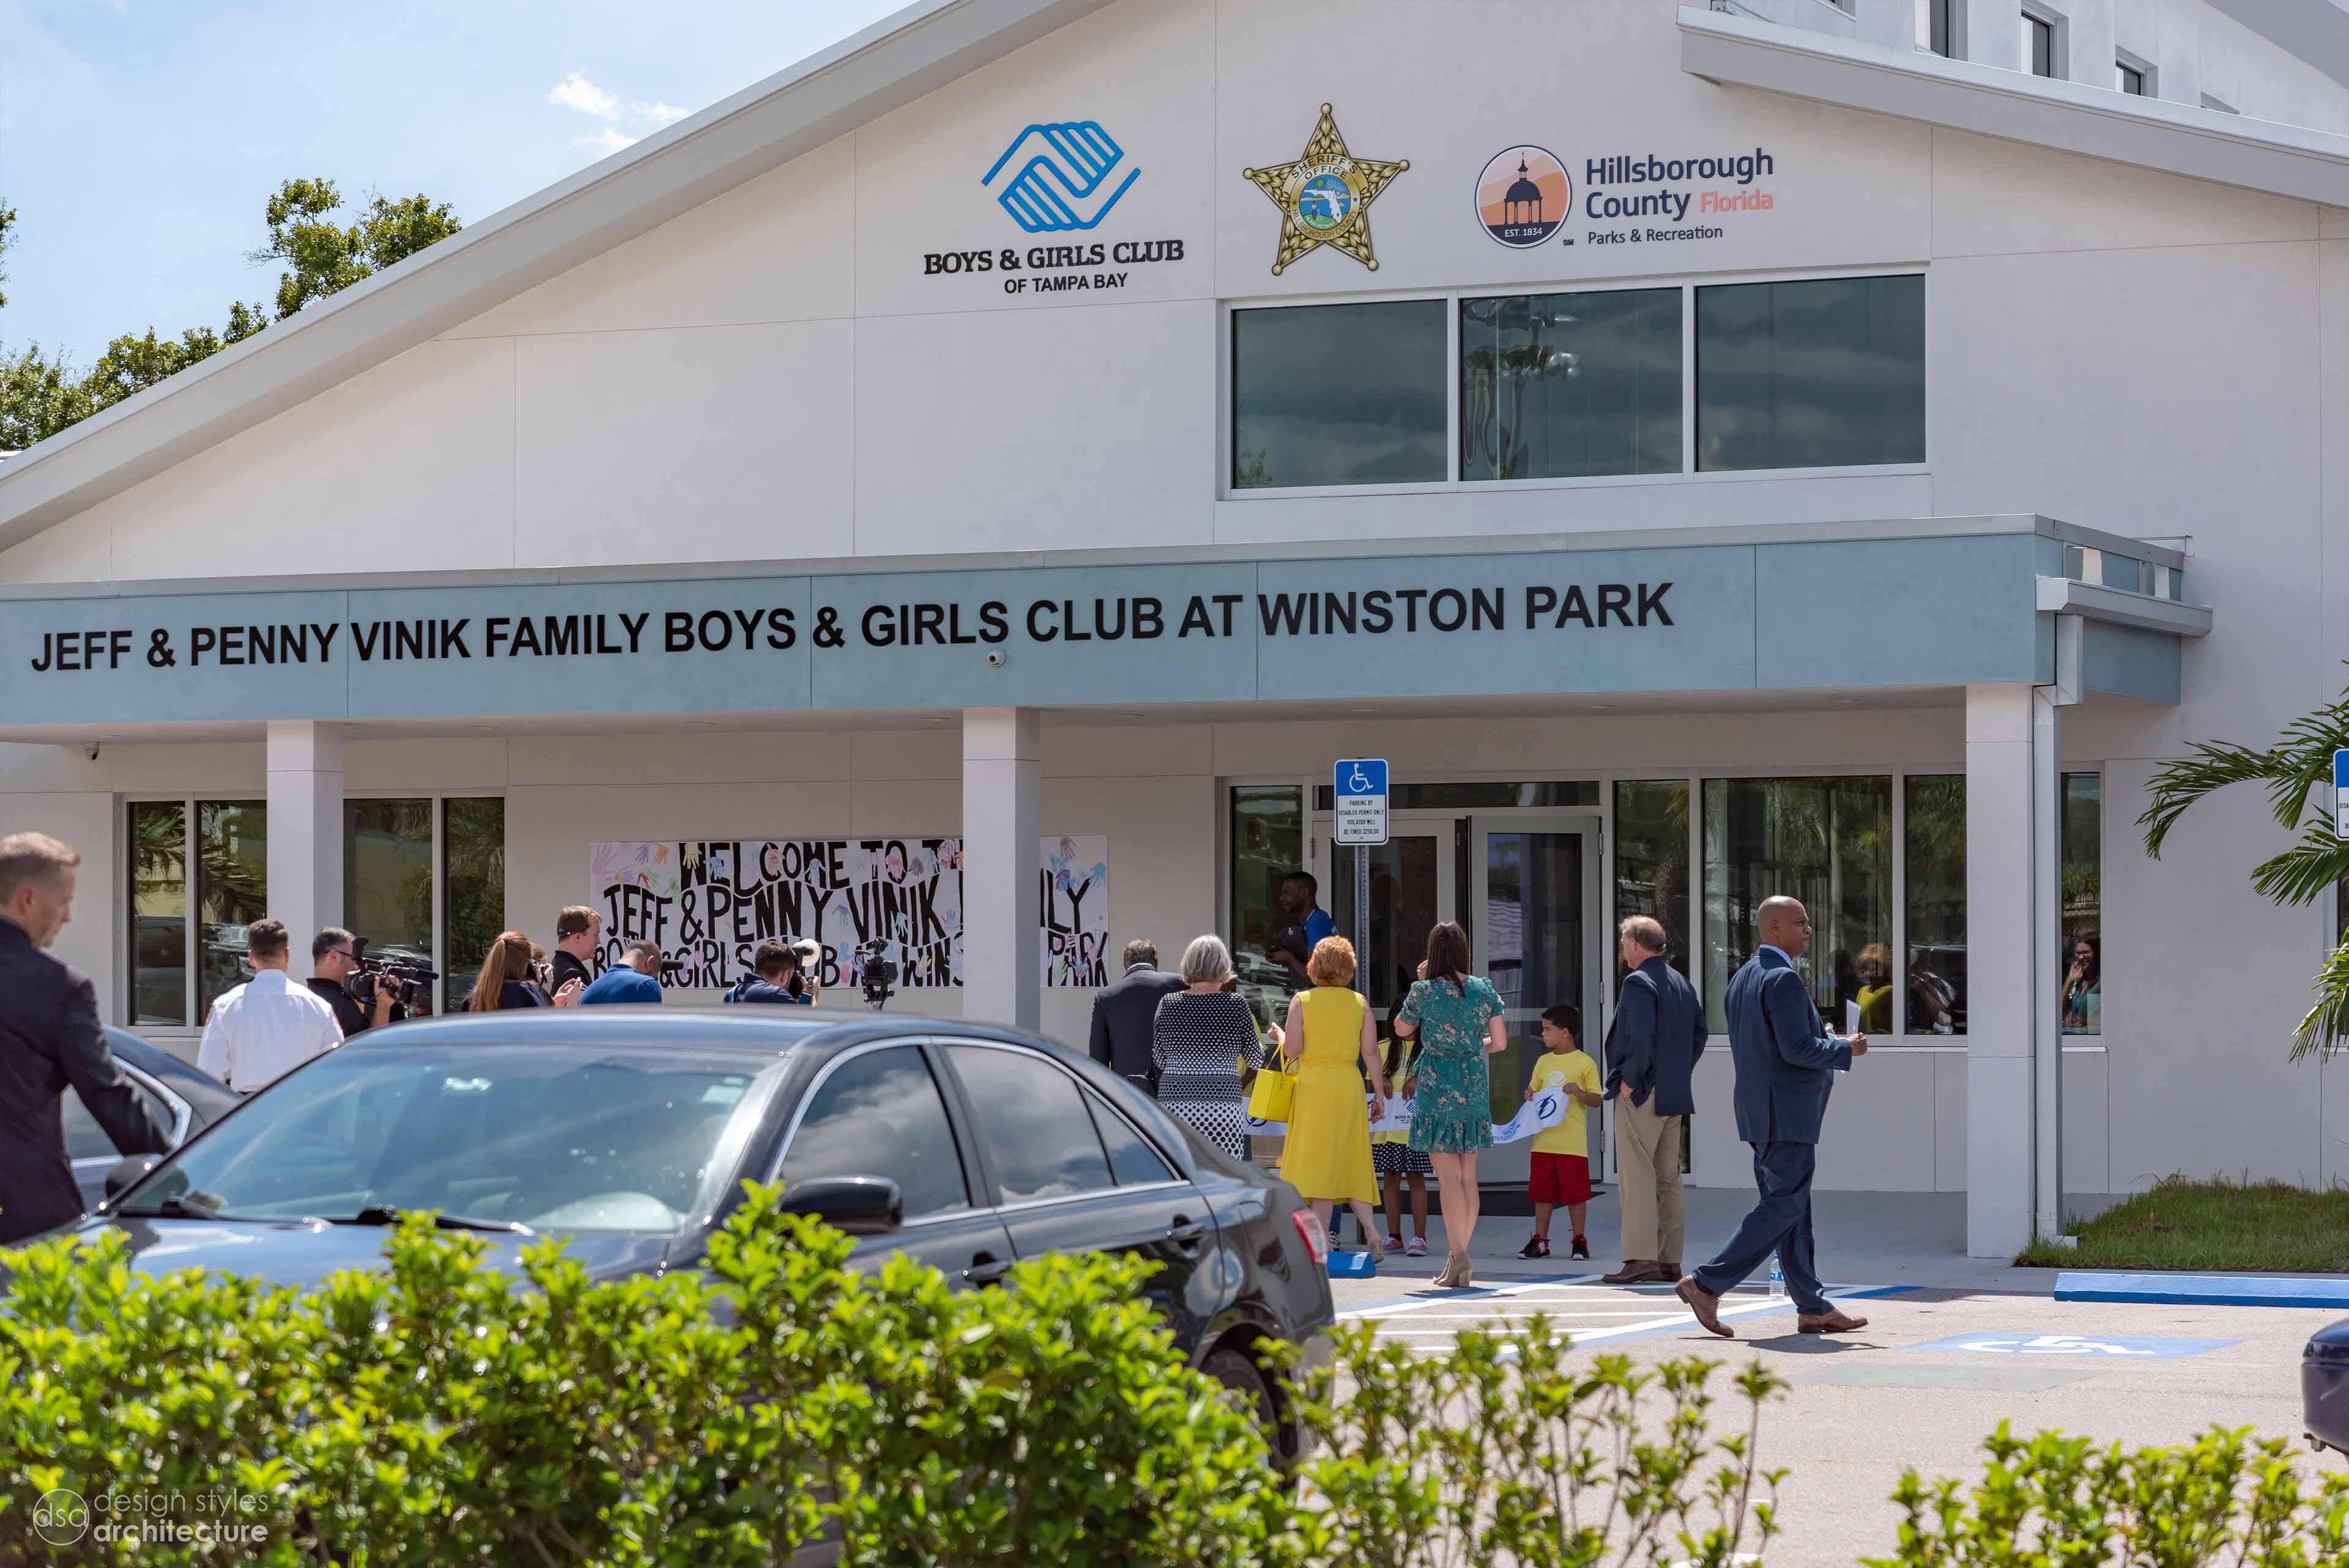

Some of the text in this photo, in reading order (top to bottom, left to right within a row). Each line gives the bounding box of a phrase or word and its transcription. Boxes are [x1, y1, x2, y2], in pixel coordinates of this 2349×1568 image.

[1291, 155, 1357, 178] SHERIFF'S
[1305, 166, 1348, 179] OFFICE
[1586, 148, 1773, 185] Hillsborough
[1586, 188, 1772, 222] County Florida
[1291, 209, 1334, 238] HILLSBOROUGH
[1336, 209, 1356, 234] COUNTY
[1505, 227, 1543, 237] EST. 1834
[1588, 225, 1723, 245] Parks & Recreation
[924, 239, 1184, 275] BOYS & GIRLS CLUB
[1004, 272, 1128, 294] OF TAMPA BAY
[31, 583, 1674, 672] JEFF & PENNY VINIK FAMILY BOYS & GIRLS CLUB AT WINSTON PARK
[678, 841, 850, 897] WELCOME
[860, 840, 908, 885] TO
[604, 883, 672, 949] JEFF
[680, 889, 705, 946] &
[706, 880, 834, 944] PENNY
[845, 873, 948, 948] VINIK
[674, 940, 755, 989] GIRLS
[1047, 931, 1108, 987] PARK
